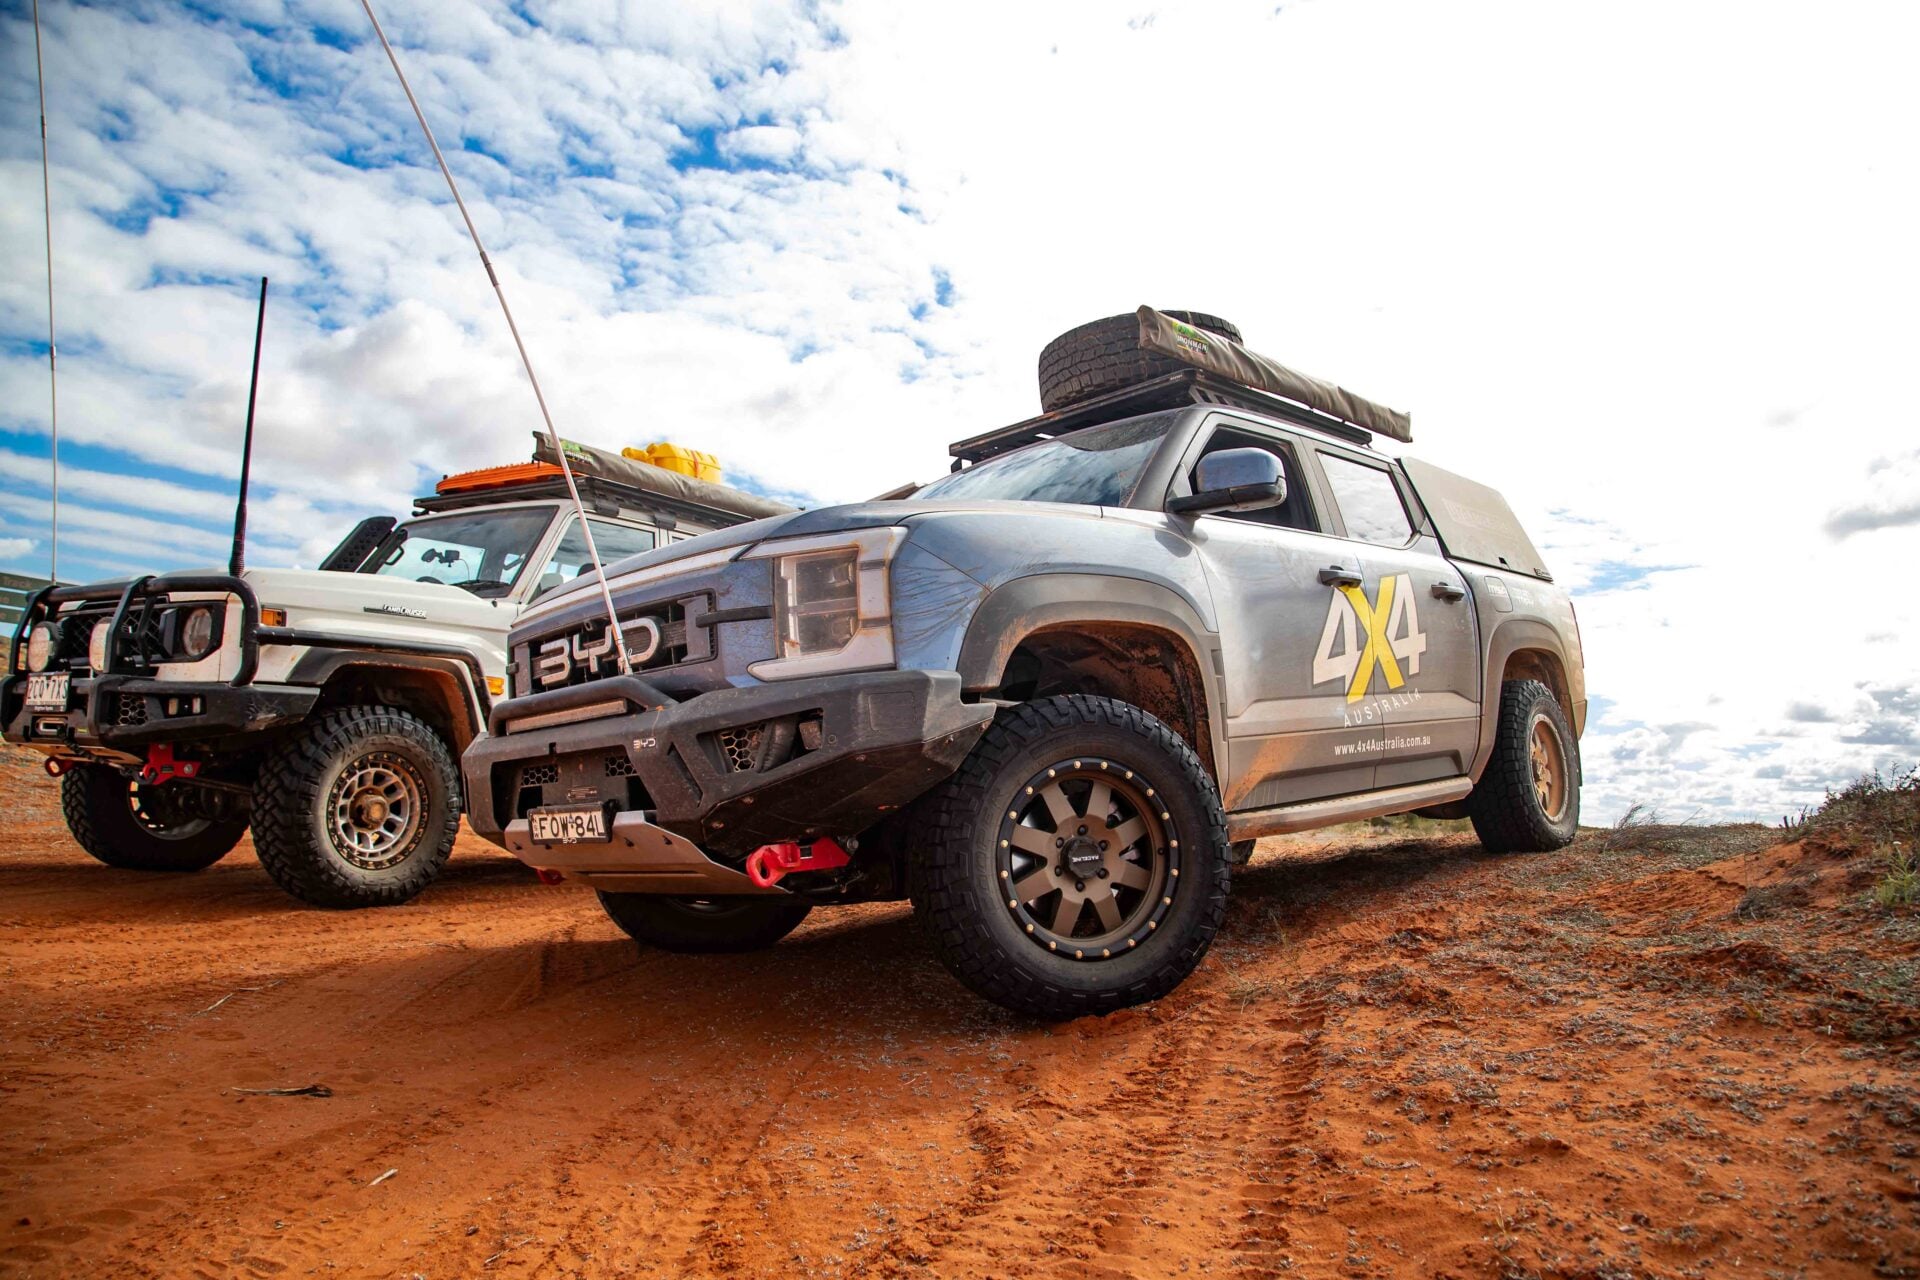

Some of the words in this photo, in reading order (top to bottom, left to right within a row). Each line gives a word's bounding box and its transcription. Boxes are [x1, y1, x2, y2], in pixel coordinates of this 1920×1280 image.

[540, 618, 660, 685] BYD
[1344, 687, 1422, 728] AUSTRALIA
[633, 738, 656, 749] BYD
[1334, 734, 1431, 756] www.4x4Australia.com.au
